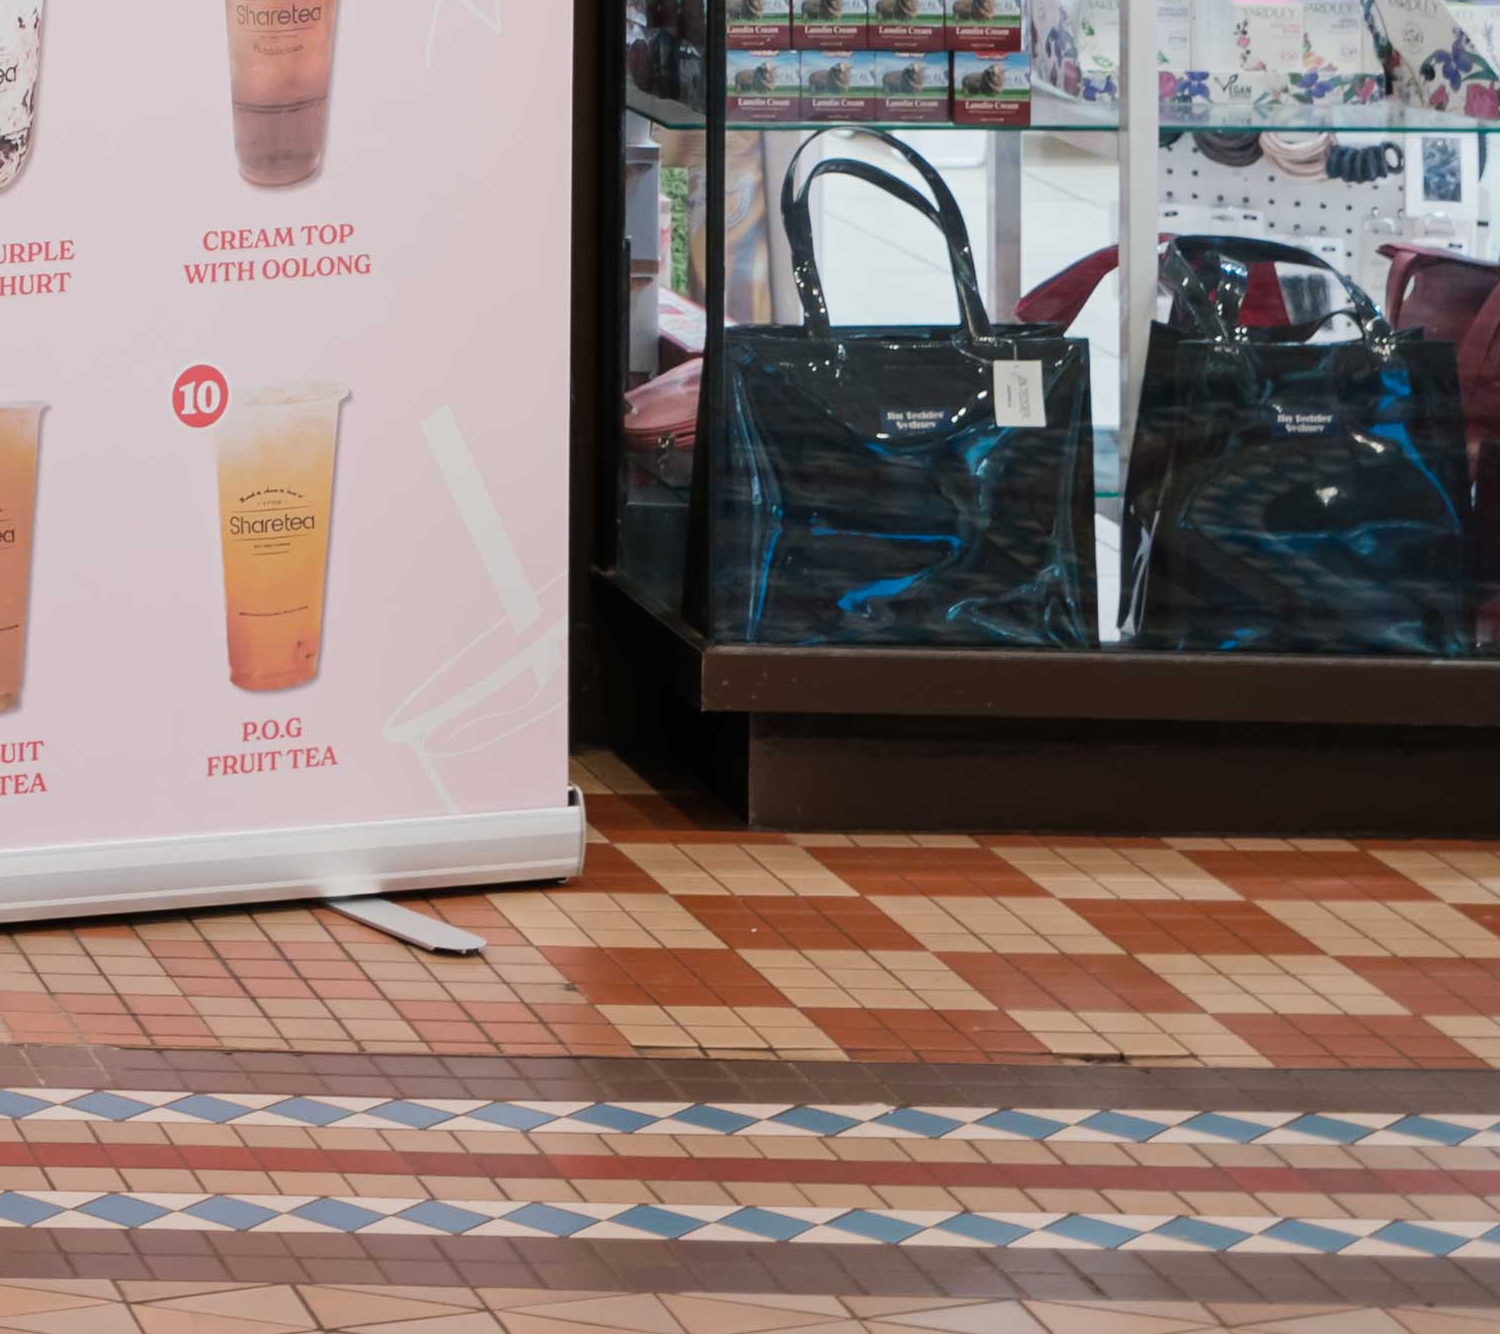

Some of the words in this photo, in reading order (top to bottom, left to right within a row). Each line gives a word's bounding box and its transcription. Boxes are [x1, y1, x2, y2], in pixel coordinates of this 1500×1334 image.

[236, 3, 322, 27] Sharetea
[203, 227, 295, 252] CREAM
[301, 223, 355, 246] TOP
[184, 260, 255, 284] WITH
[261, 255, 372, 280] OOLONG
[180, 380, 221, 415] 10
[229, 513, 316, 535] Sharetea
[242, 717, 302, 742] P.O.G
[206, 750, 281, 778] FRUIT
[286, 745, 338, 770] TEA
